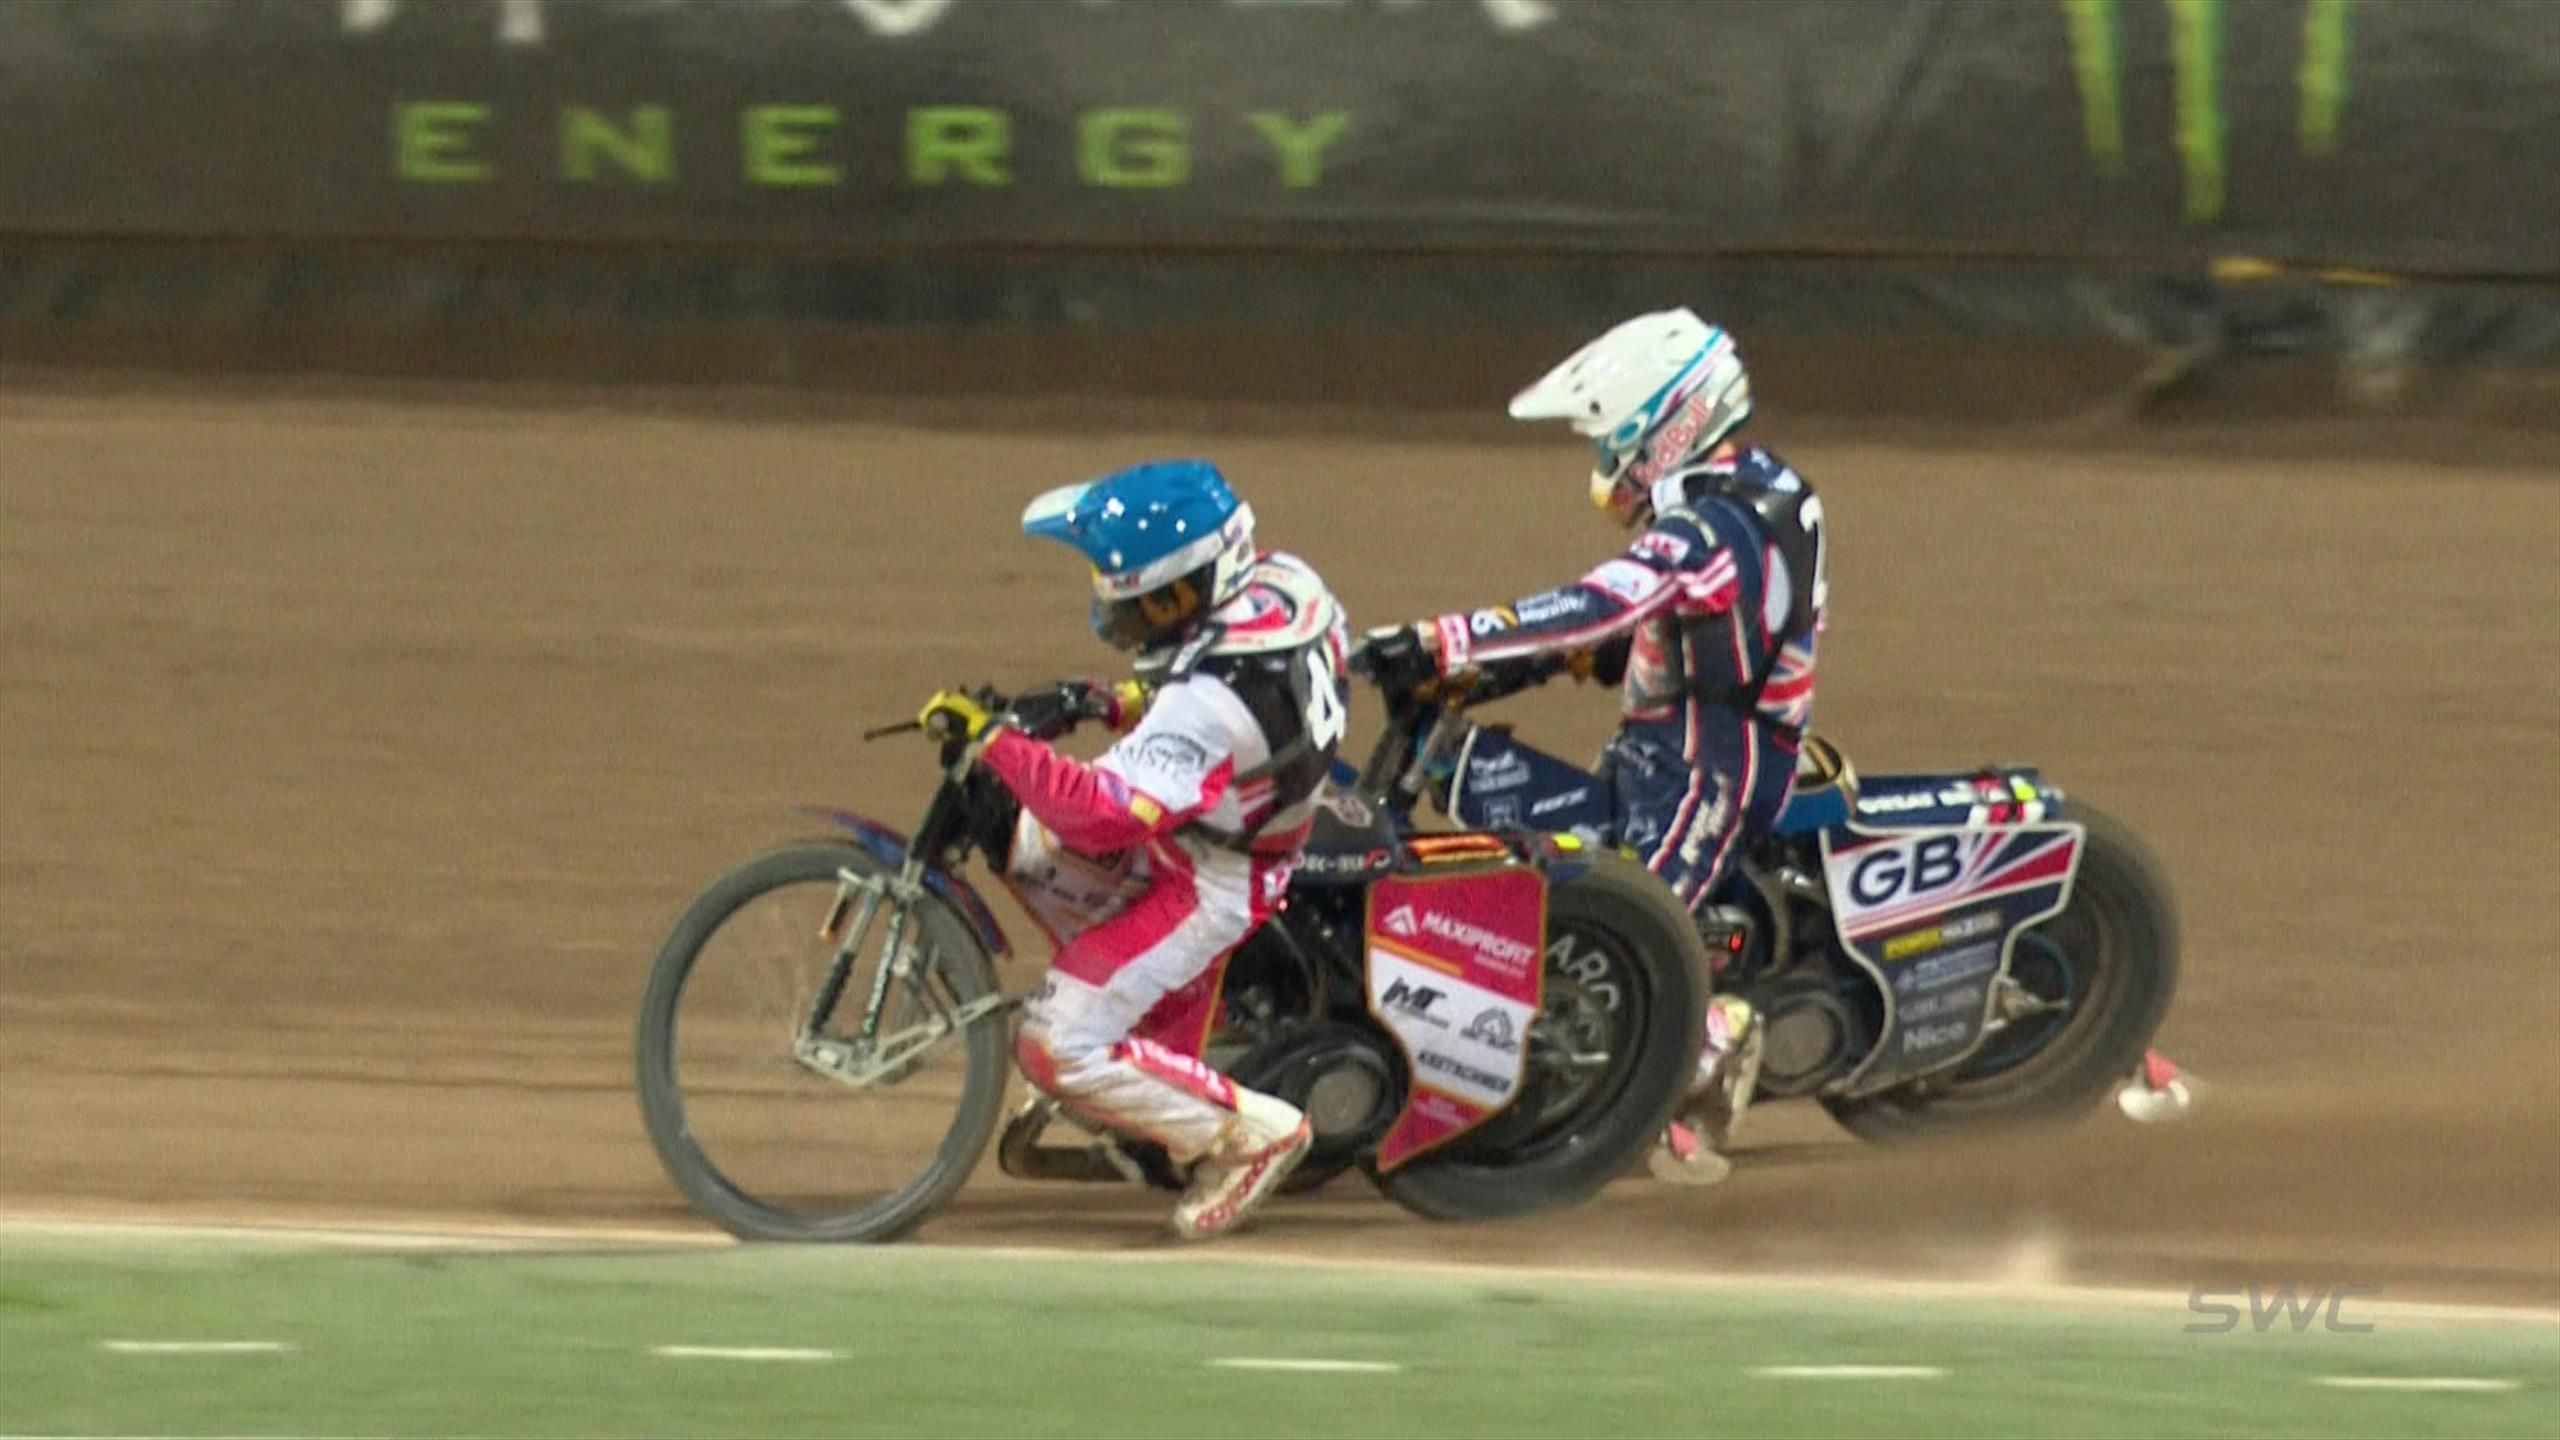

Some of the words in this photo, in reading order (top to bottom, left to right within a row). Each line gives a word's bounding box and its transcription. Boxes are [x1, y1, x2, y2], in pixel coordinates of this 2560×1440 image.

[392, 101, 1356, 188] ENERGY
[1307, 650, 1347, 751] 4
[1850, 834, 1962, 907] GB
[1421, 911, 1537, 964] MAXIPROFIT
